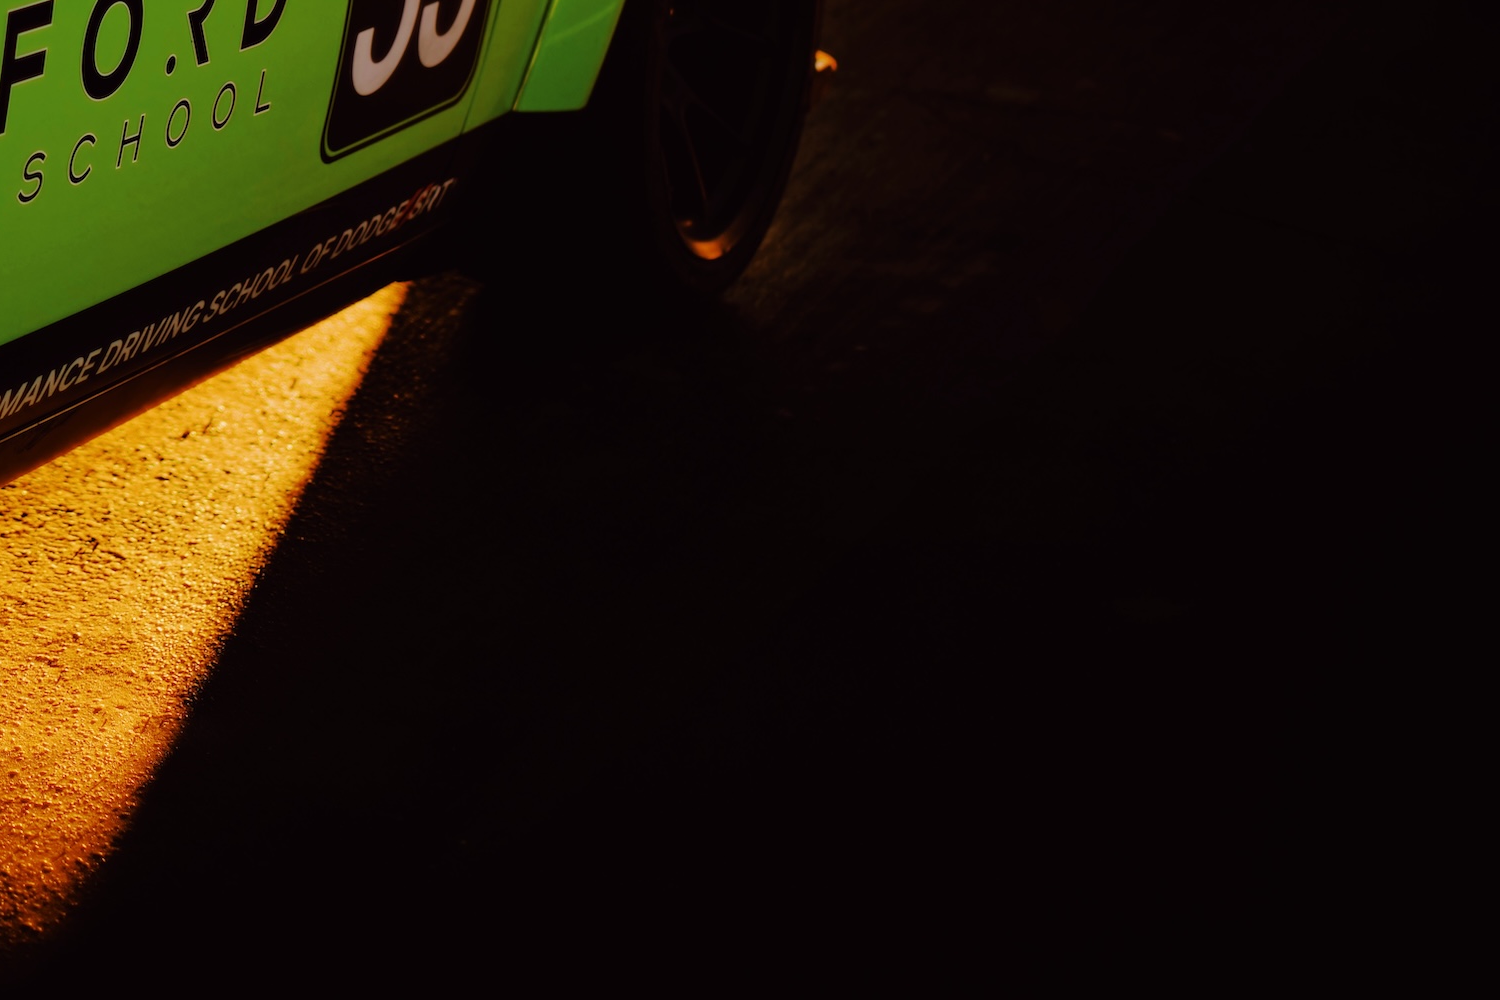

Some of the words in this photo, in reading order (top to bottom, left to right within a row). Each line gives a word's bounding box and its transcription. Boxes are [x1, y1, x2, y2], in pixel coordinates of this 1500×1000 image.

[16, 68, 273, 204] SCHOOL
[95, 299, 207, 373] DRIVING
[201, 252, 300, 324] SCHOOL
[299, 234, 338, 275] OF
